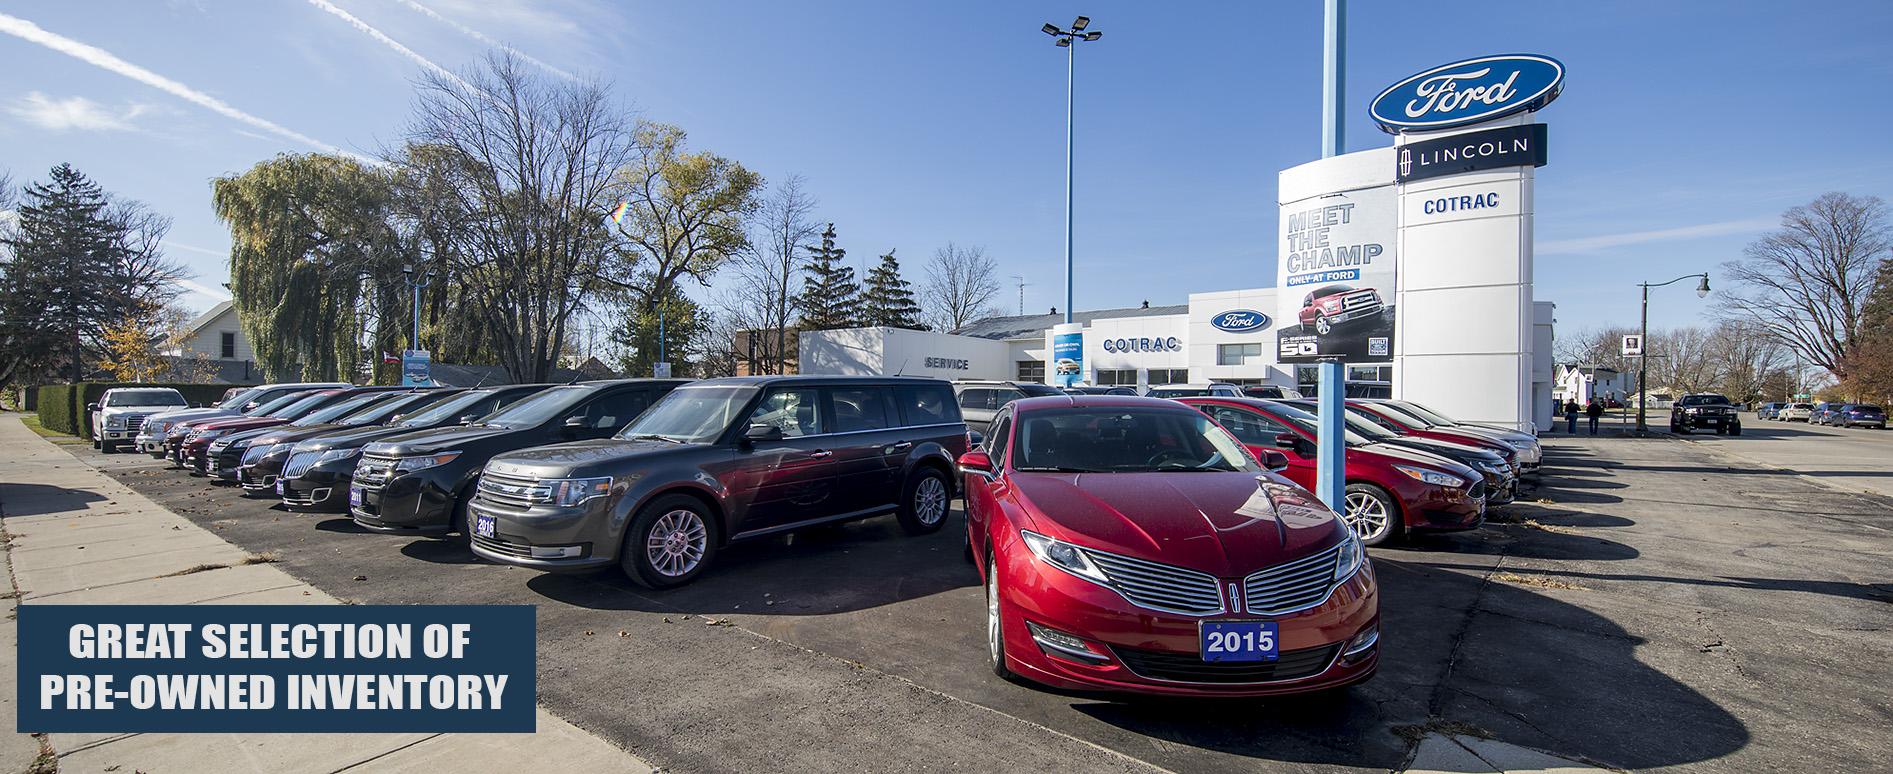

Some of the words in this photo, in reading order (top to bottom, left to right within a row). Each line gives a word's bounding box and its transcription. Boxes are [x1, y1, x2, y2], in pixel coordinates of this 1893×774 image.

[1405, 67, 1521, 118] Ford
[1421, 137, 1528, 166] LINCOLN
[1424, 192, 1500, 215] COTRAC
[1288, 203, 1354, 233] MEET
[1287, 227, 1330, 253] THE
[1287, 243, 1383, 273] CHAMP
[1289, 275, 1311, 285] ONLY
[1313, 274, 1324, 283] AT
[1327, 271, 1355, 281] FORD
[1222, 313, 1254, 327] Ford
[1103, 336, 1178, 351] COTRAC
[925, 357, 969, 370] SERVICE
[478, 518, 495, 532] 2016
[1207, 631, 1274, 653] 2015
